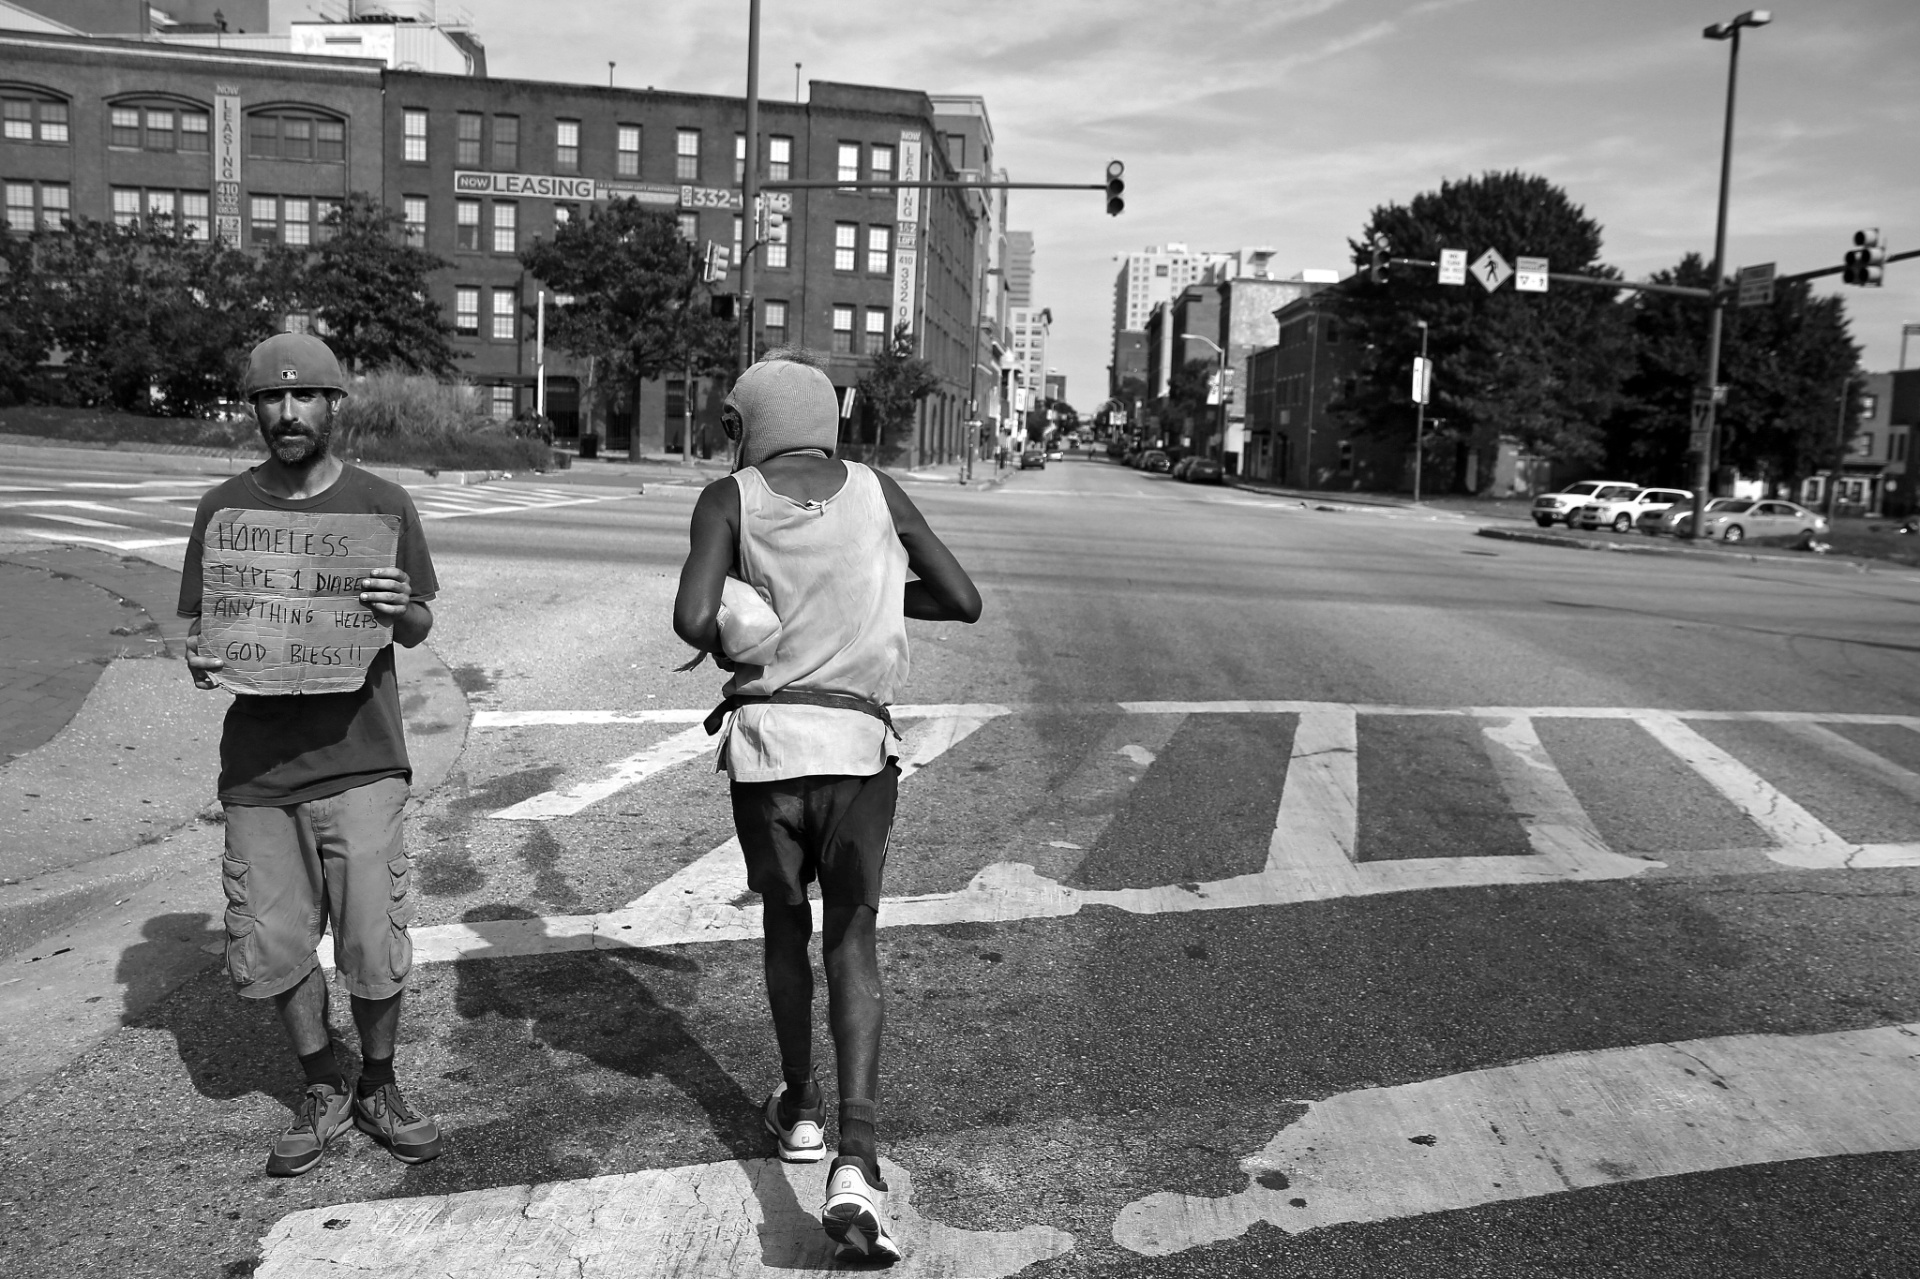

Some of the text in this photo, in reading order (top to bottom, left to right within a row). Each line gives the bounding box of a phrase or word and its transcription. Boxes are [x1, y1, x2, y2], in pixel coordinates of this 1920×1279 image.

[216, 84, 239, 95] NOW
[222, 99, 233, 179] LEASING
[901, 131, 921, 141] NOW
[217, 183, 238, 194] 410
[460, 176, 489, 189] NOW
[493, 176, 592, 198] LEASING
[218, 522, 350, 557] HOMELESS
[210, 564, 276, 589] TYPE
[290, 569, 304, 591] 1
[214, 598, 378, 629] ANYTHING HELPS
[225, 641, 267, 662] GOD
